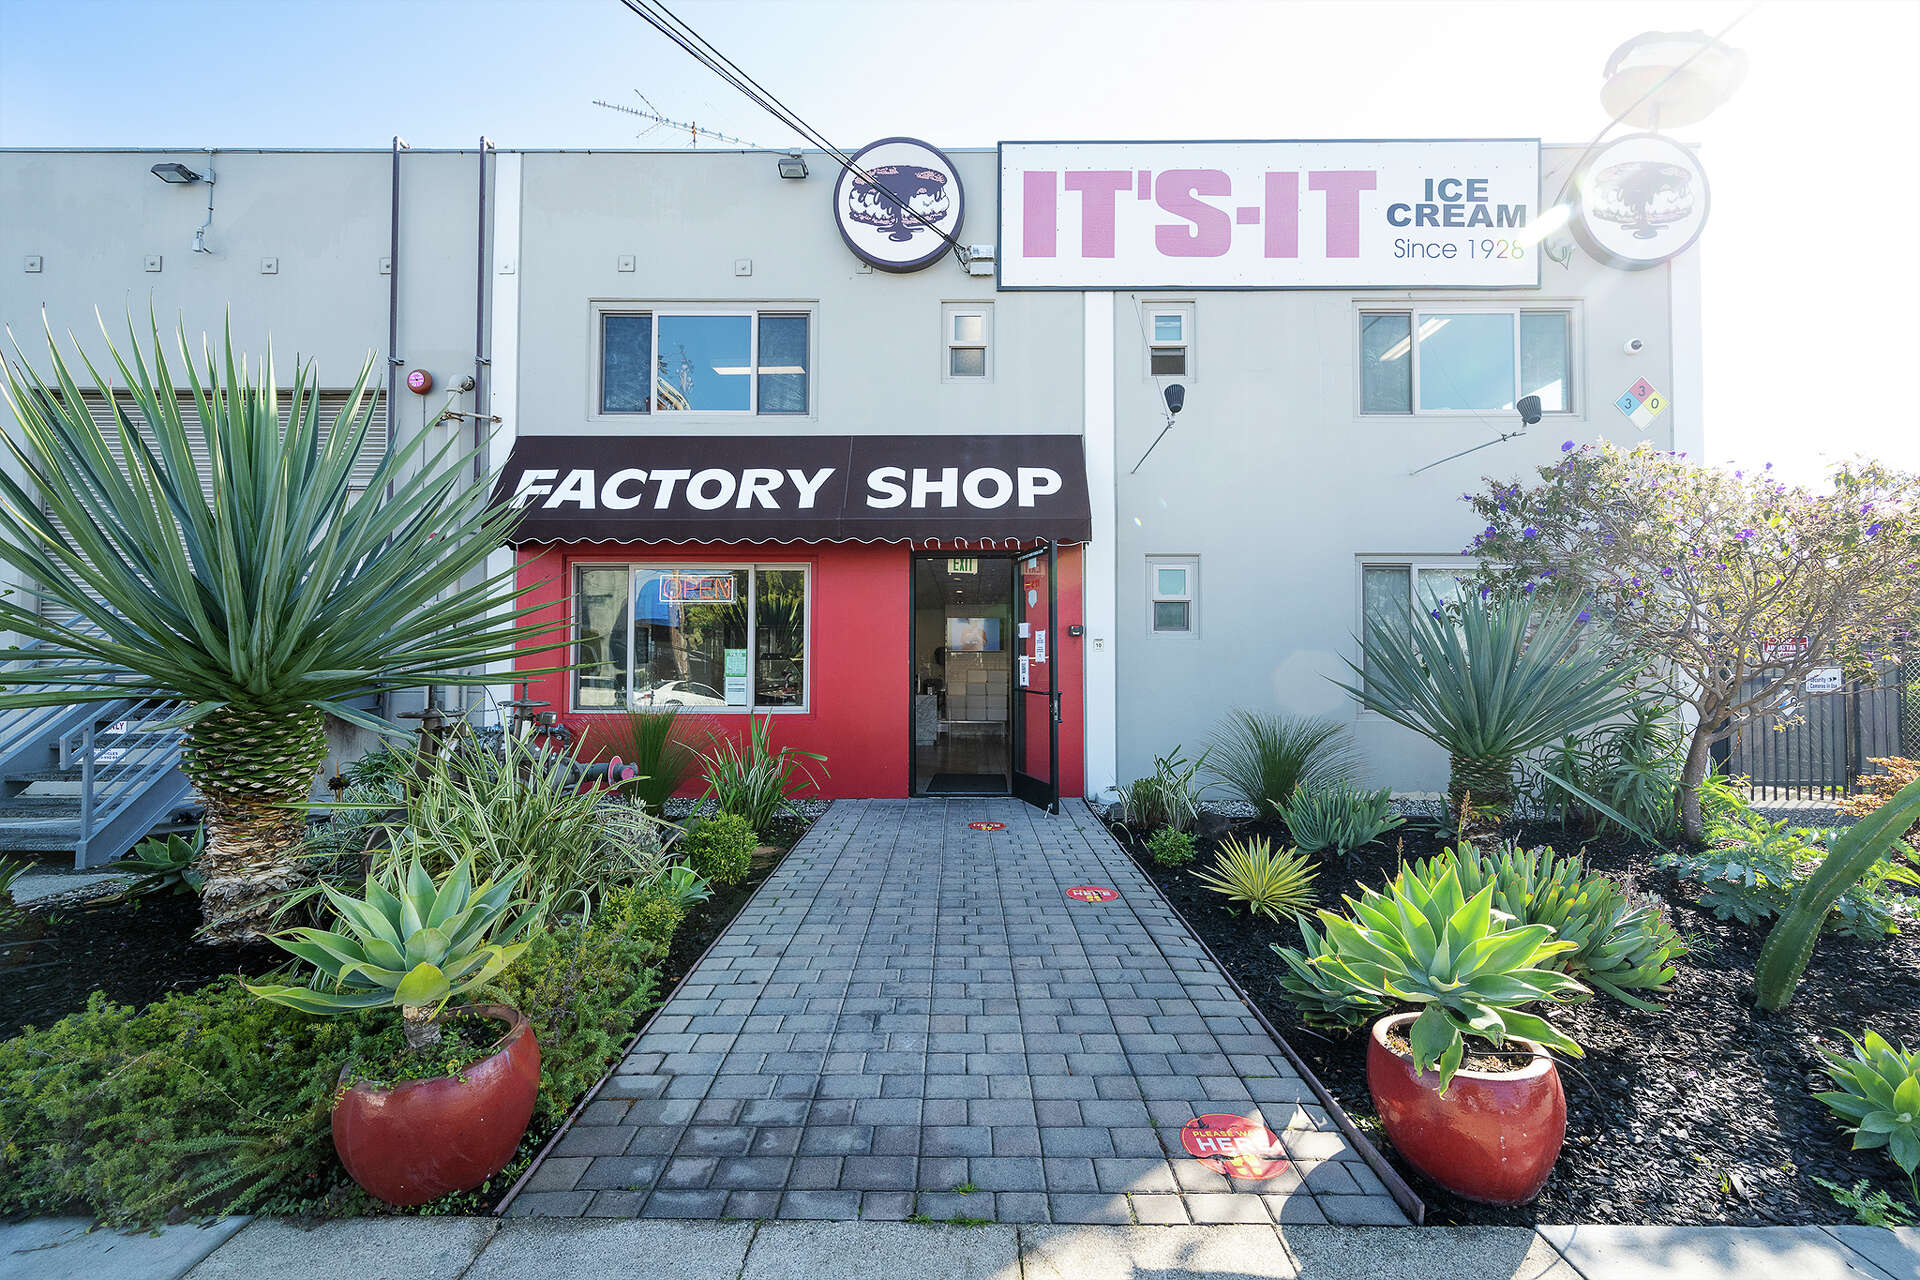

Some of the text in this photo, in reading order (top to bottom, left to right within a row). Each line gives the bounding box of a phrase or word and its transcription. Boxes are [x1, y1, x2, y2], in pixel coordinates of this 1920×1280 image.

[1425, 178, 1488, 202] ICE
[1023, 169, 1377, 258] IT'S-IT
[1386, 203, 1527, 228] CREAM
[1394, 238, 1525, 260] Since 1928
[1638, 385, 1646, 397] 3
[1624, 398, 1659, 409] 3 0
[508, 466, 1063, 510] FACTORY SHOP
[953, 558, 973, 571] EXIT
[663, 577, 732, 600] OPEN
[1192, 1130, 1235, 1138] PLEASE
